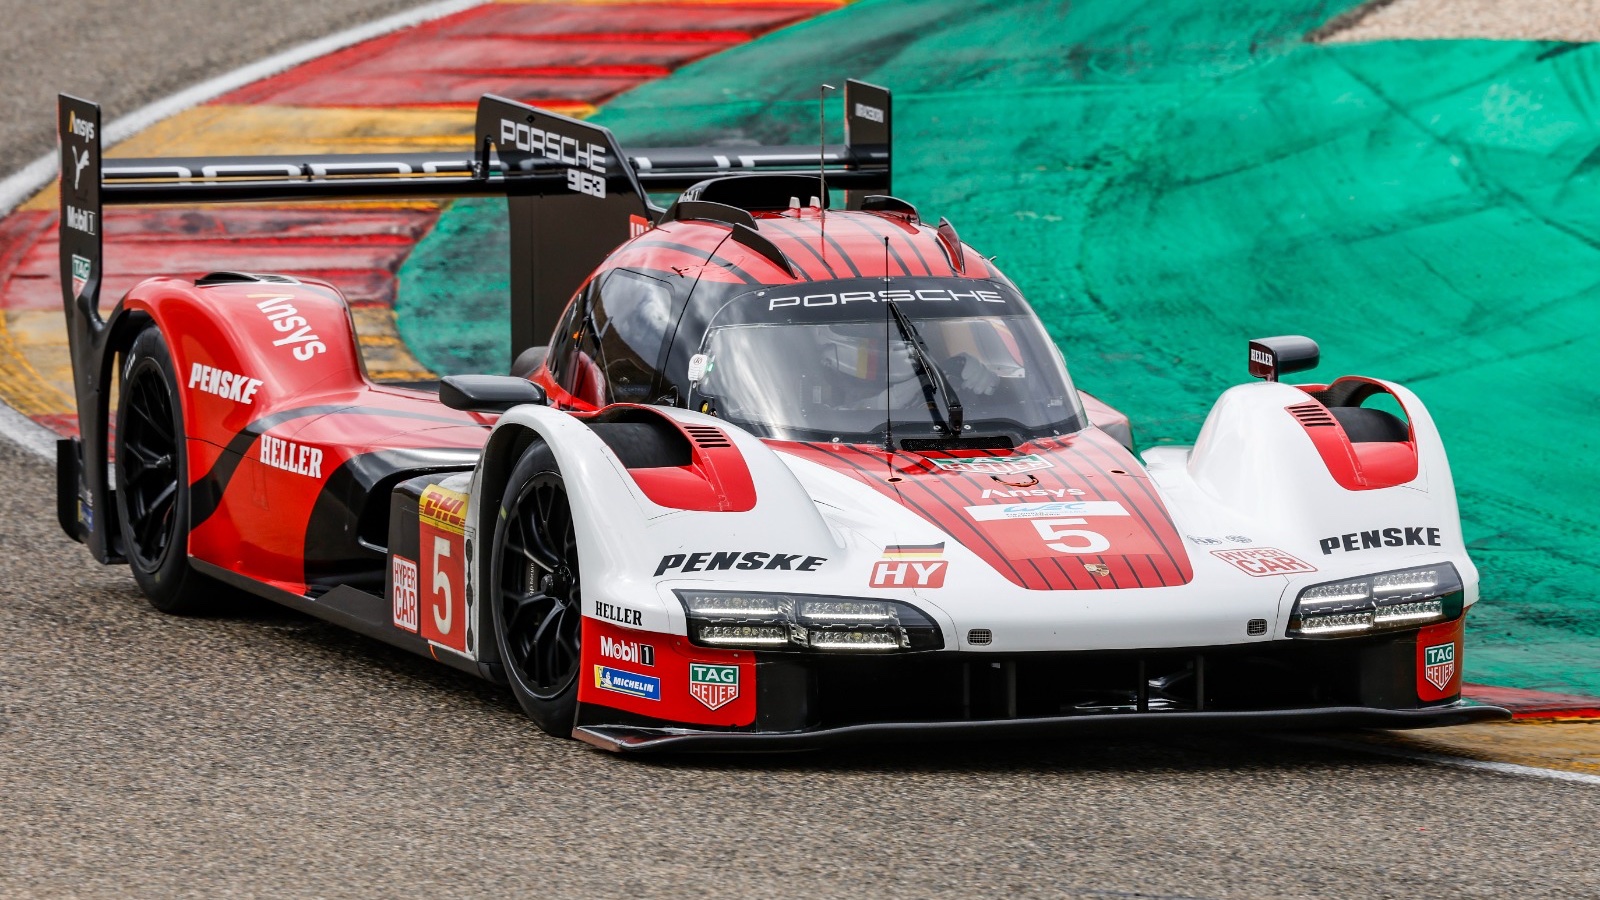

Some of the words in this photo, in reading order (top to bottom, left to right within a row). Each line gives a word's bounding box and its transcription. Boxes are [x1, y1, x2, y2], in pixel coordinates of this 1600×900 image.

[68, 110, 94, 143] Ansys
[501, 118, 606, 174] PORSCHE
[567, 168, 606, 199] 963
[67, 205, 88, 232] Mobil
[768, 289, 1006, 310] PORSCHE
[247, 294, 327, 361] Ansys
[1251, 349, 1273, 366] HELLER
[188, 362, 264, 404] PENSKE
[259, 434, 323, 479] HELLER
[981, 488, 1086, 499] Ansys
[1032, 517, 1110, 554] 5
[1319, 527, 1441, 555] PENSKE
[653, 551, 828, 578] PENSKE
[1217, 548, 1286, 561] HYPER
[1235, 556, 1310, 574] CAR
[394, 560, 416, 591] HYPER
[433, 535, 452, 635] 5
[873, 562, 939, 585] HY
[394, 587, 417, 627] CAR
[595, 601, 642, 626] HELLER
[600, 635, 639, 664] Mobil
[1428, 646, 1452, 663] TAG
[613, 677, 654, 692] MICHELIN
[693, 667, 734, 683] TAG
[1427, 664, 1453, 687] HEUER
[692, 684, 736, 707] HEUER
